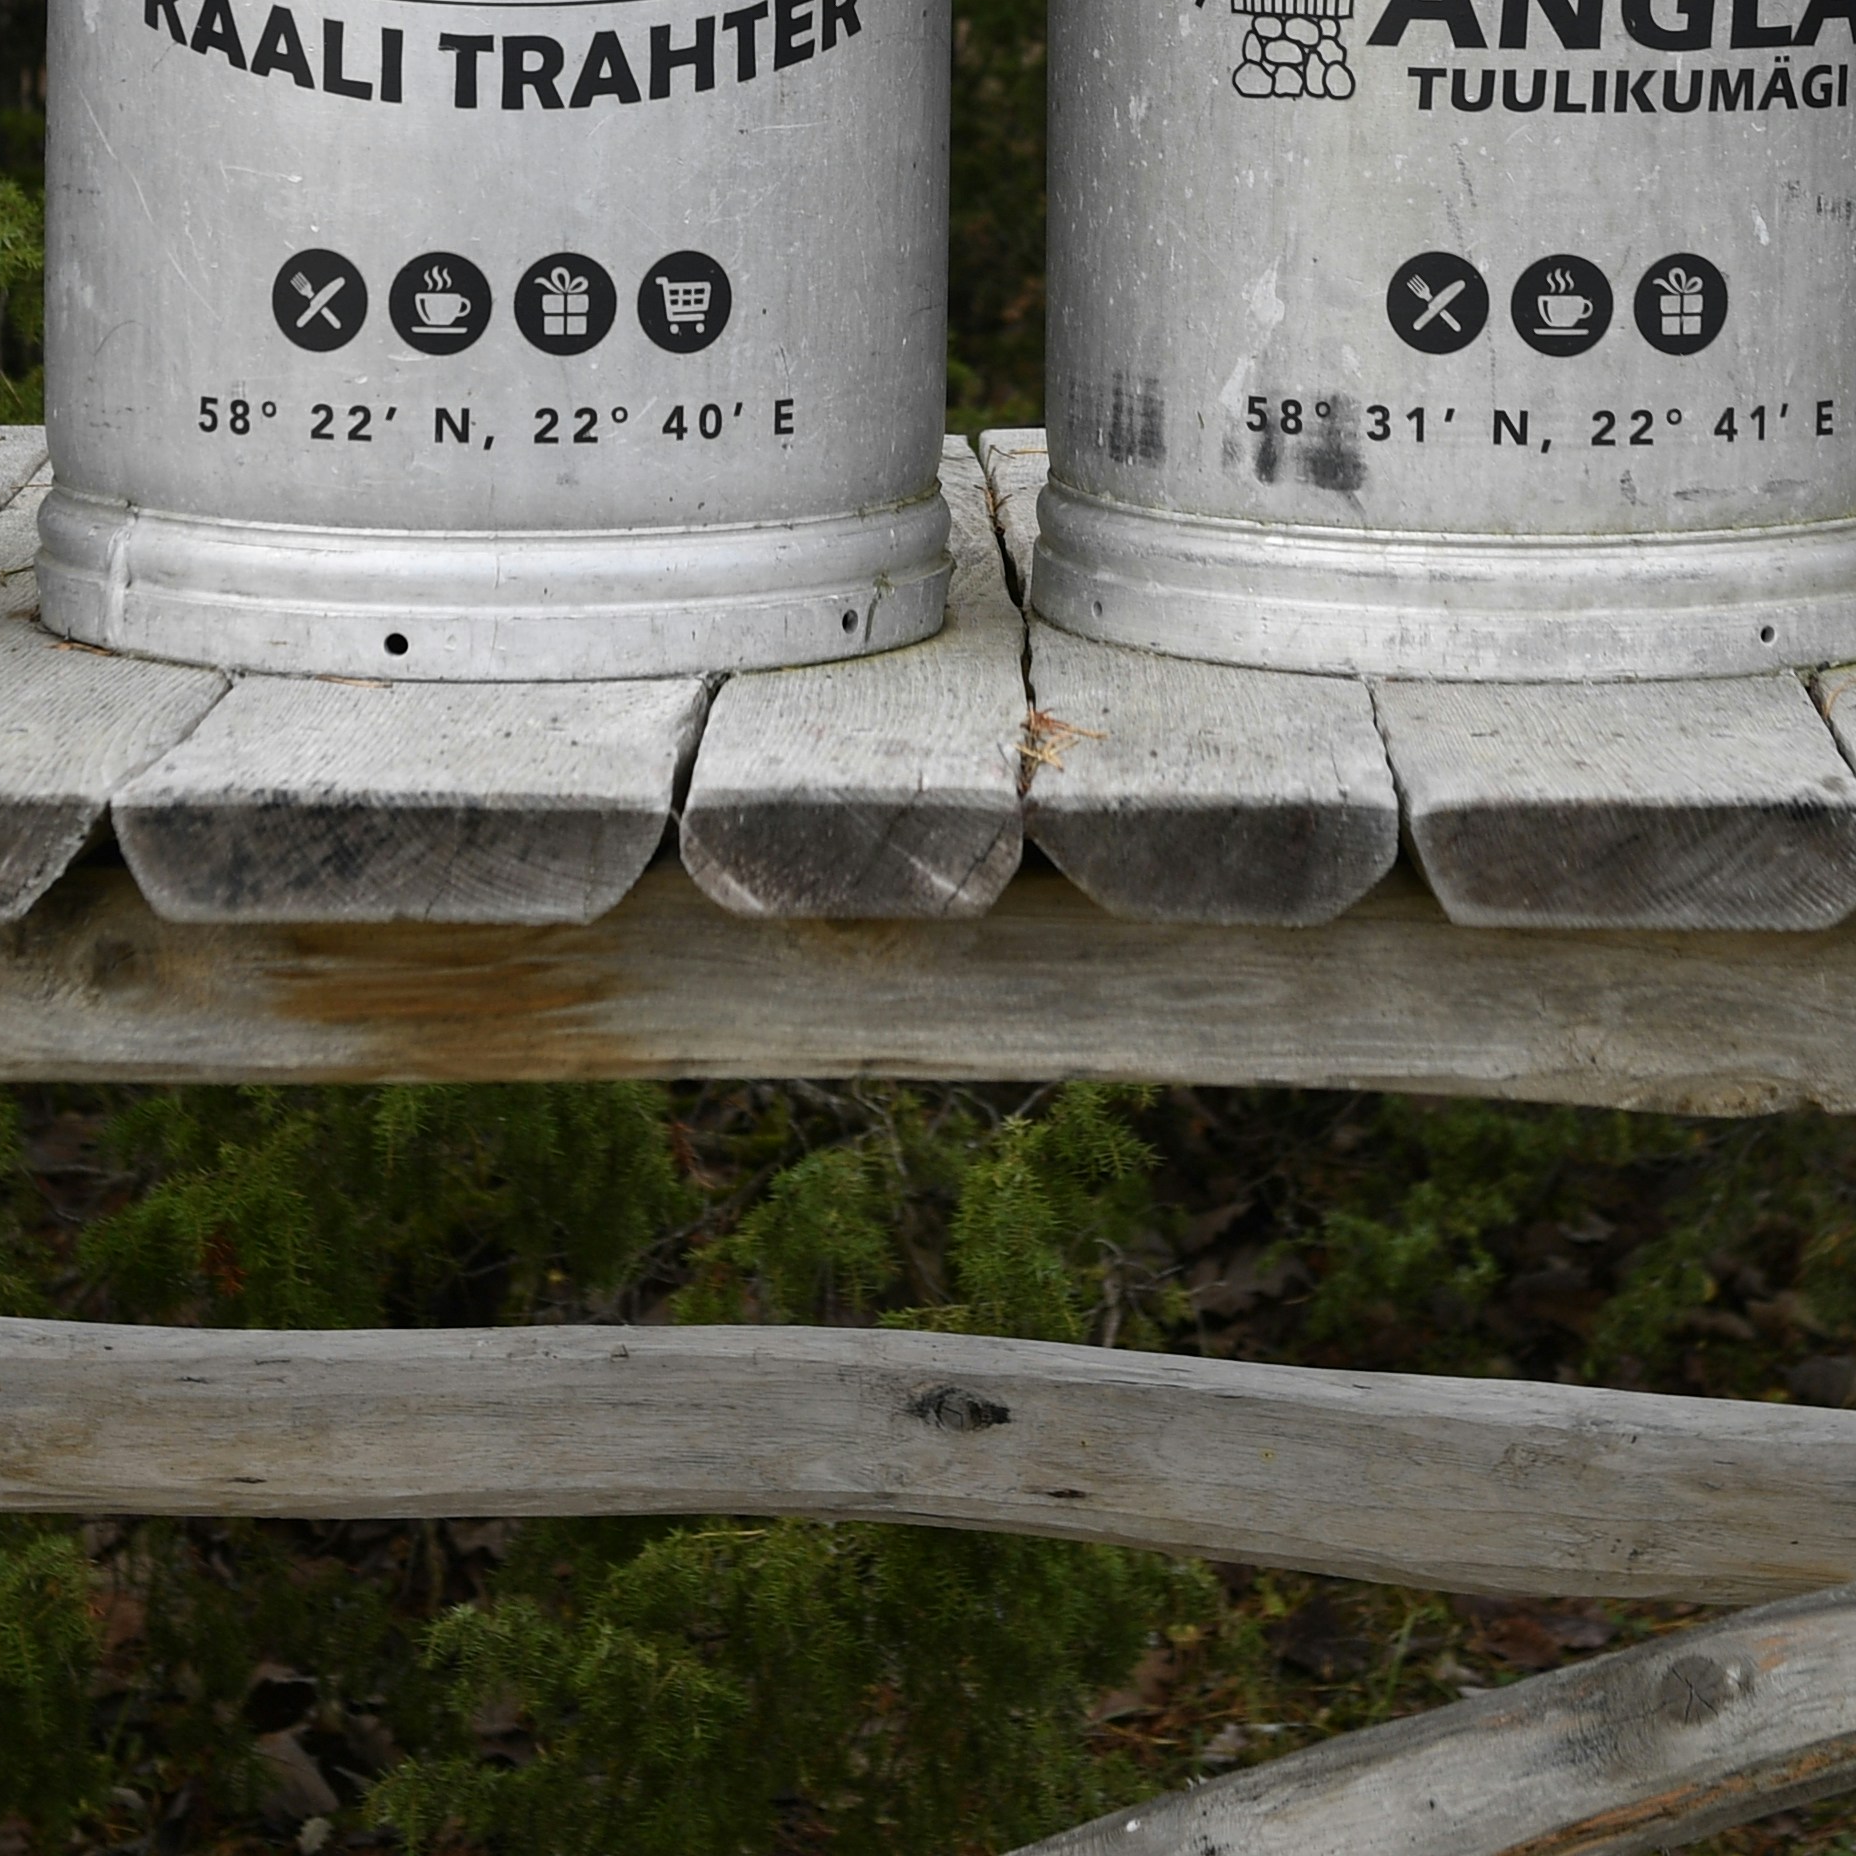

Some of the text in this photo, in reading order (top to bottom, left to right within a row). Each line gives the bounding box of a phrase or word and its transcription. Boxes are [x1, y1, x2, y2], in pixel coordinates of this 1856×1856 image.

[1408, 55, 1848, 113] TUULIKUMÄGI
[199, 397, 276, 435] 58°
[435, 408, 494, 450] N,
[534, 407, 628, 443] 22°
[775, 399, 793, 435] E
[1246, 395, 1332, 435] 58°
[1494, 410, 1551, 453] N,
[1592, 409, 1682, 446] 22°
[1816, 400, 1833, 435] E
